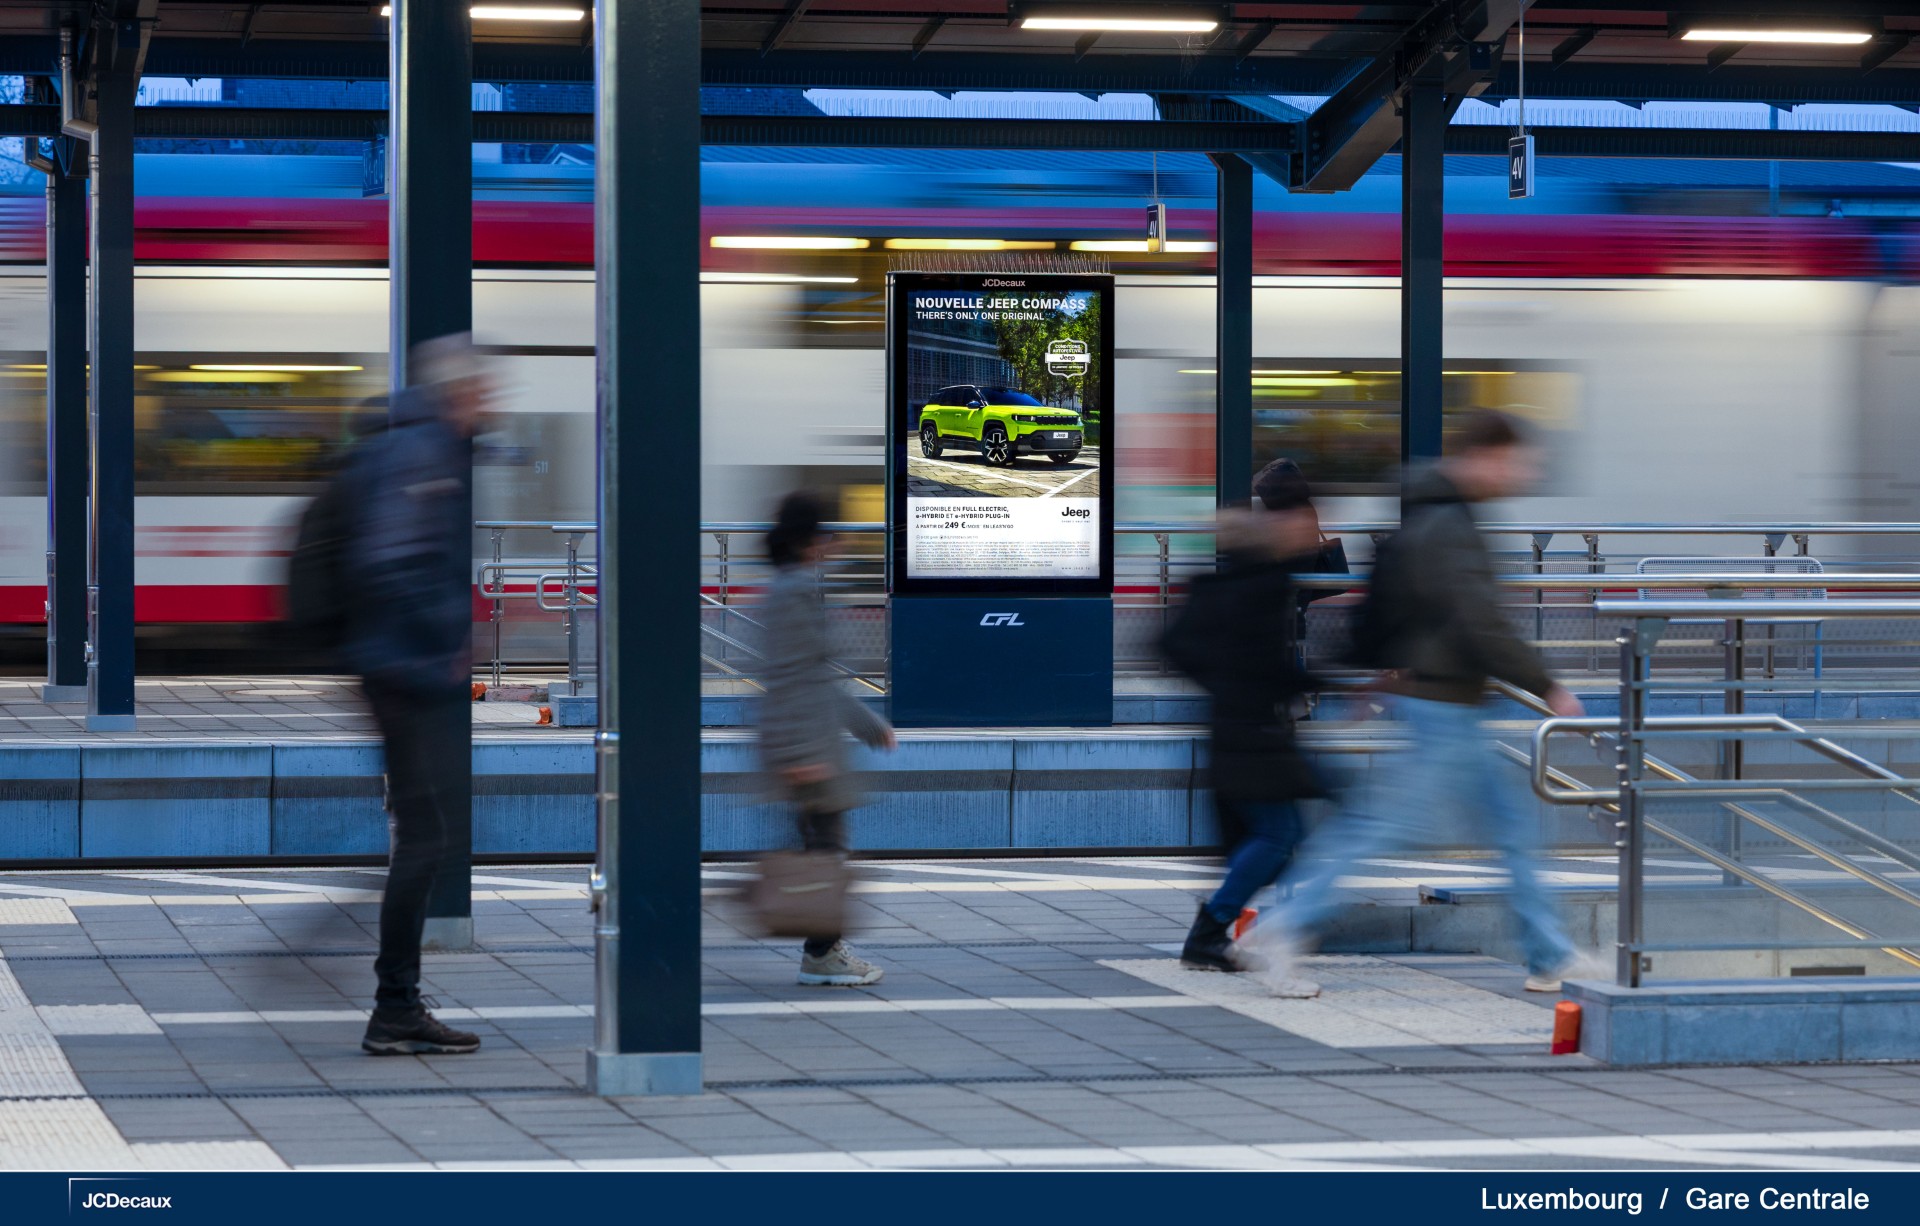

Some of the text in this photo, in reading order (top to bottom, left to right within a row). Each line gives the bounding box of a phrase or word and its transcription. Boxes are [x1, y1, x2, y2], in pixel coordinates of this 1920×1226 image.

[1512, 156, 1523, 180] 4V
[982, 279, 1026, 287] JCDecaux
[915, 297, 984, 309] NOUVELLE
[1021, 298, 1086, 310] COMPASS
[916, 311, 1045, 320] THERE'S ONLY ONE ORIGINAL
[535, 461, 549, 474] 511
[1061, 506, 1090, 519] Jeep
[944, 521, 959, 529] 249
[979, 612, 1025, 626] CFL
